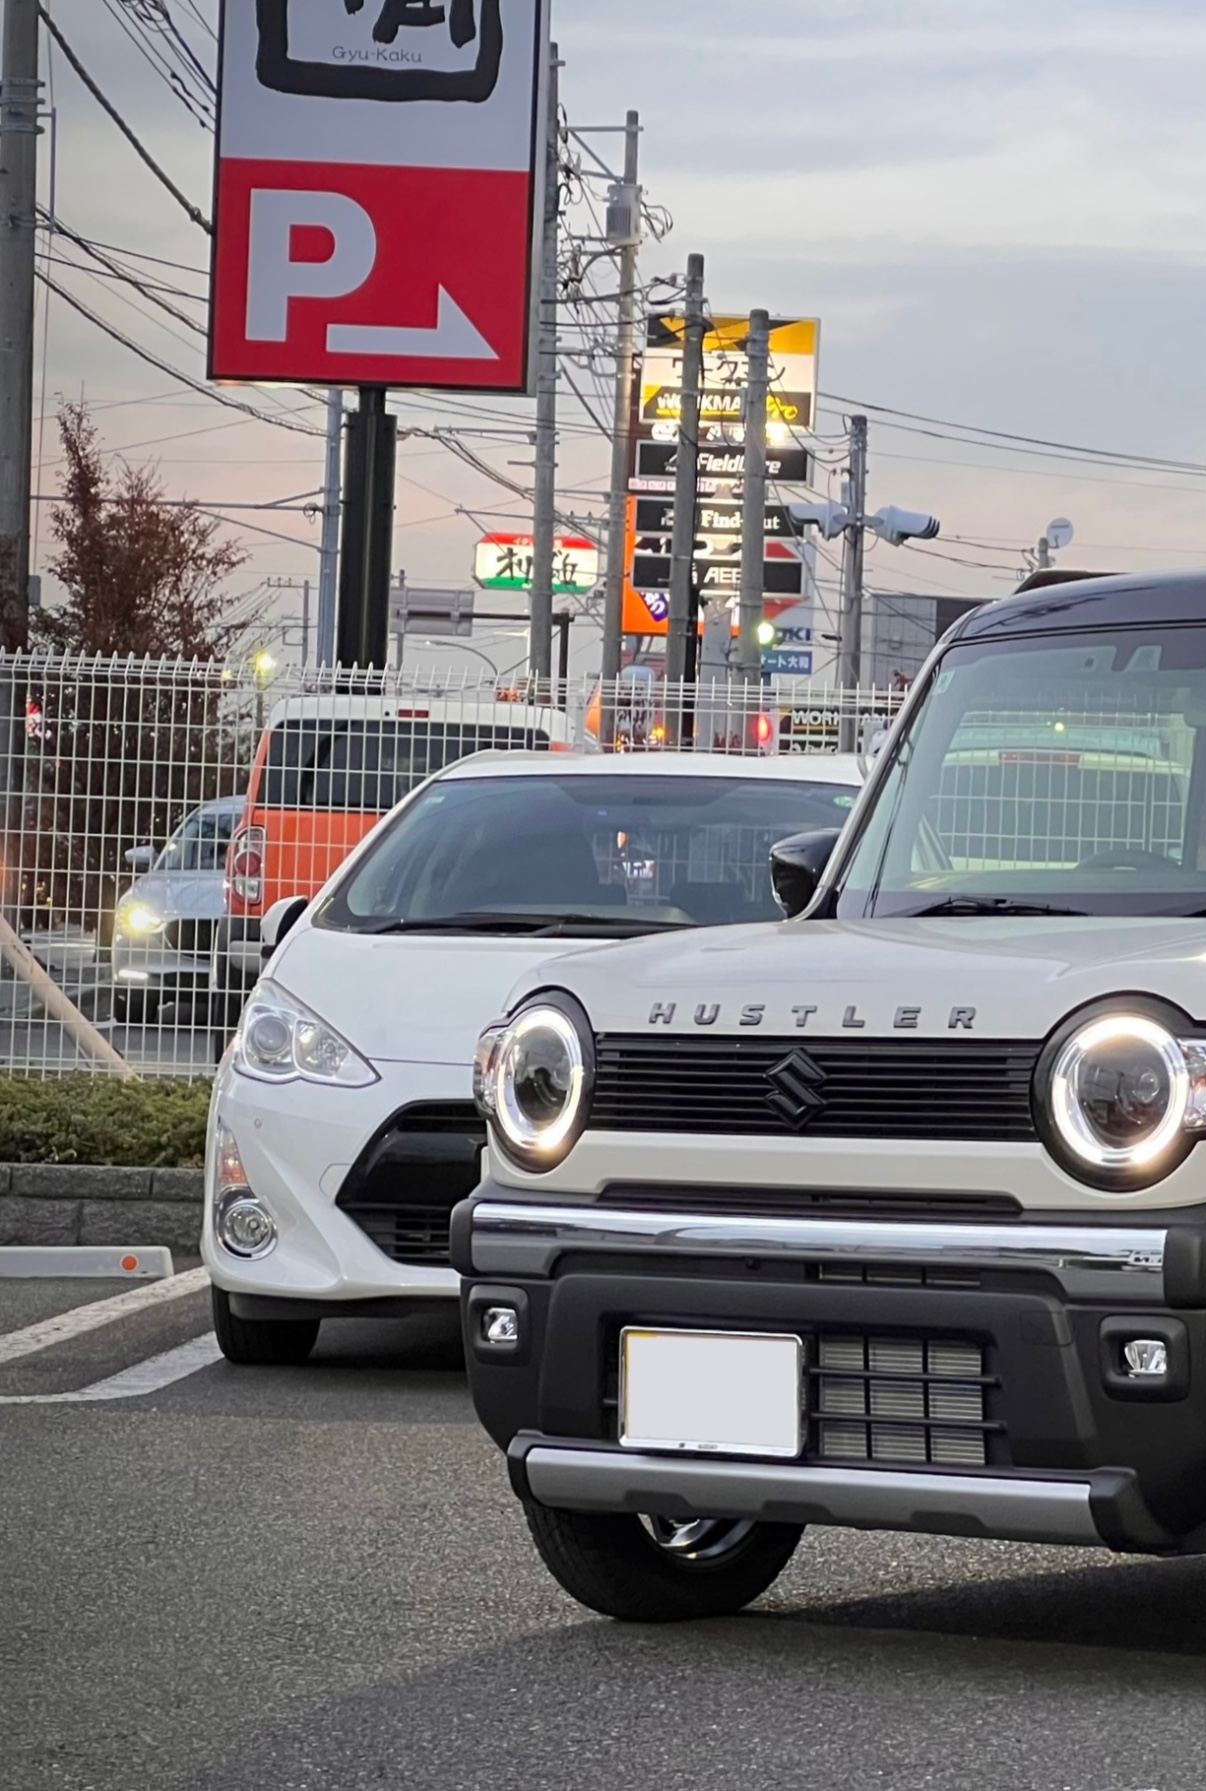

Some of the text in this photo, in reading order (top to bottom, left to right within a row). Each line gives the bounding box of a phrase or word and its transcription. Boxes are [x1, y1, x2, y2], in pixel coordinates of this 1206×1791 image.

[332, 45, 423, 64] Gyu-Kaku
[245, 188, 377, 342] P
[697, 453, 782, 474] Fieldre
[700, 509, 780, 530] Find-ut
[648, 1002, 978, 1030] HUSTLER
